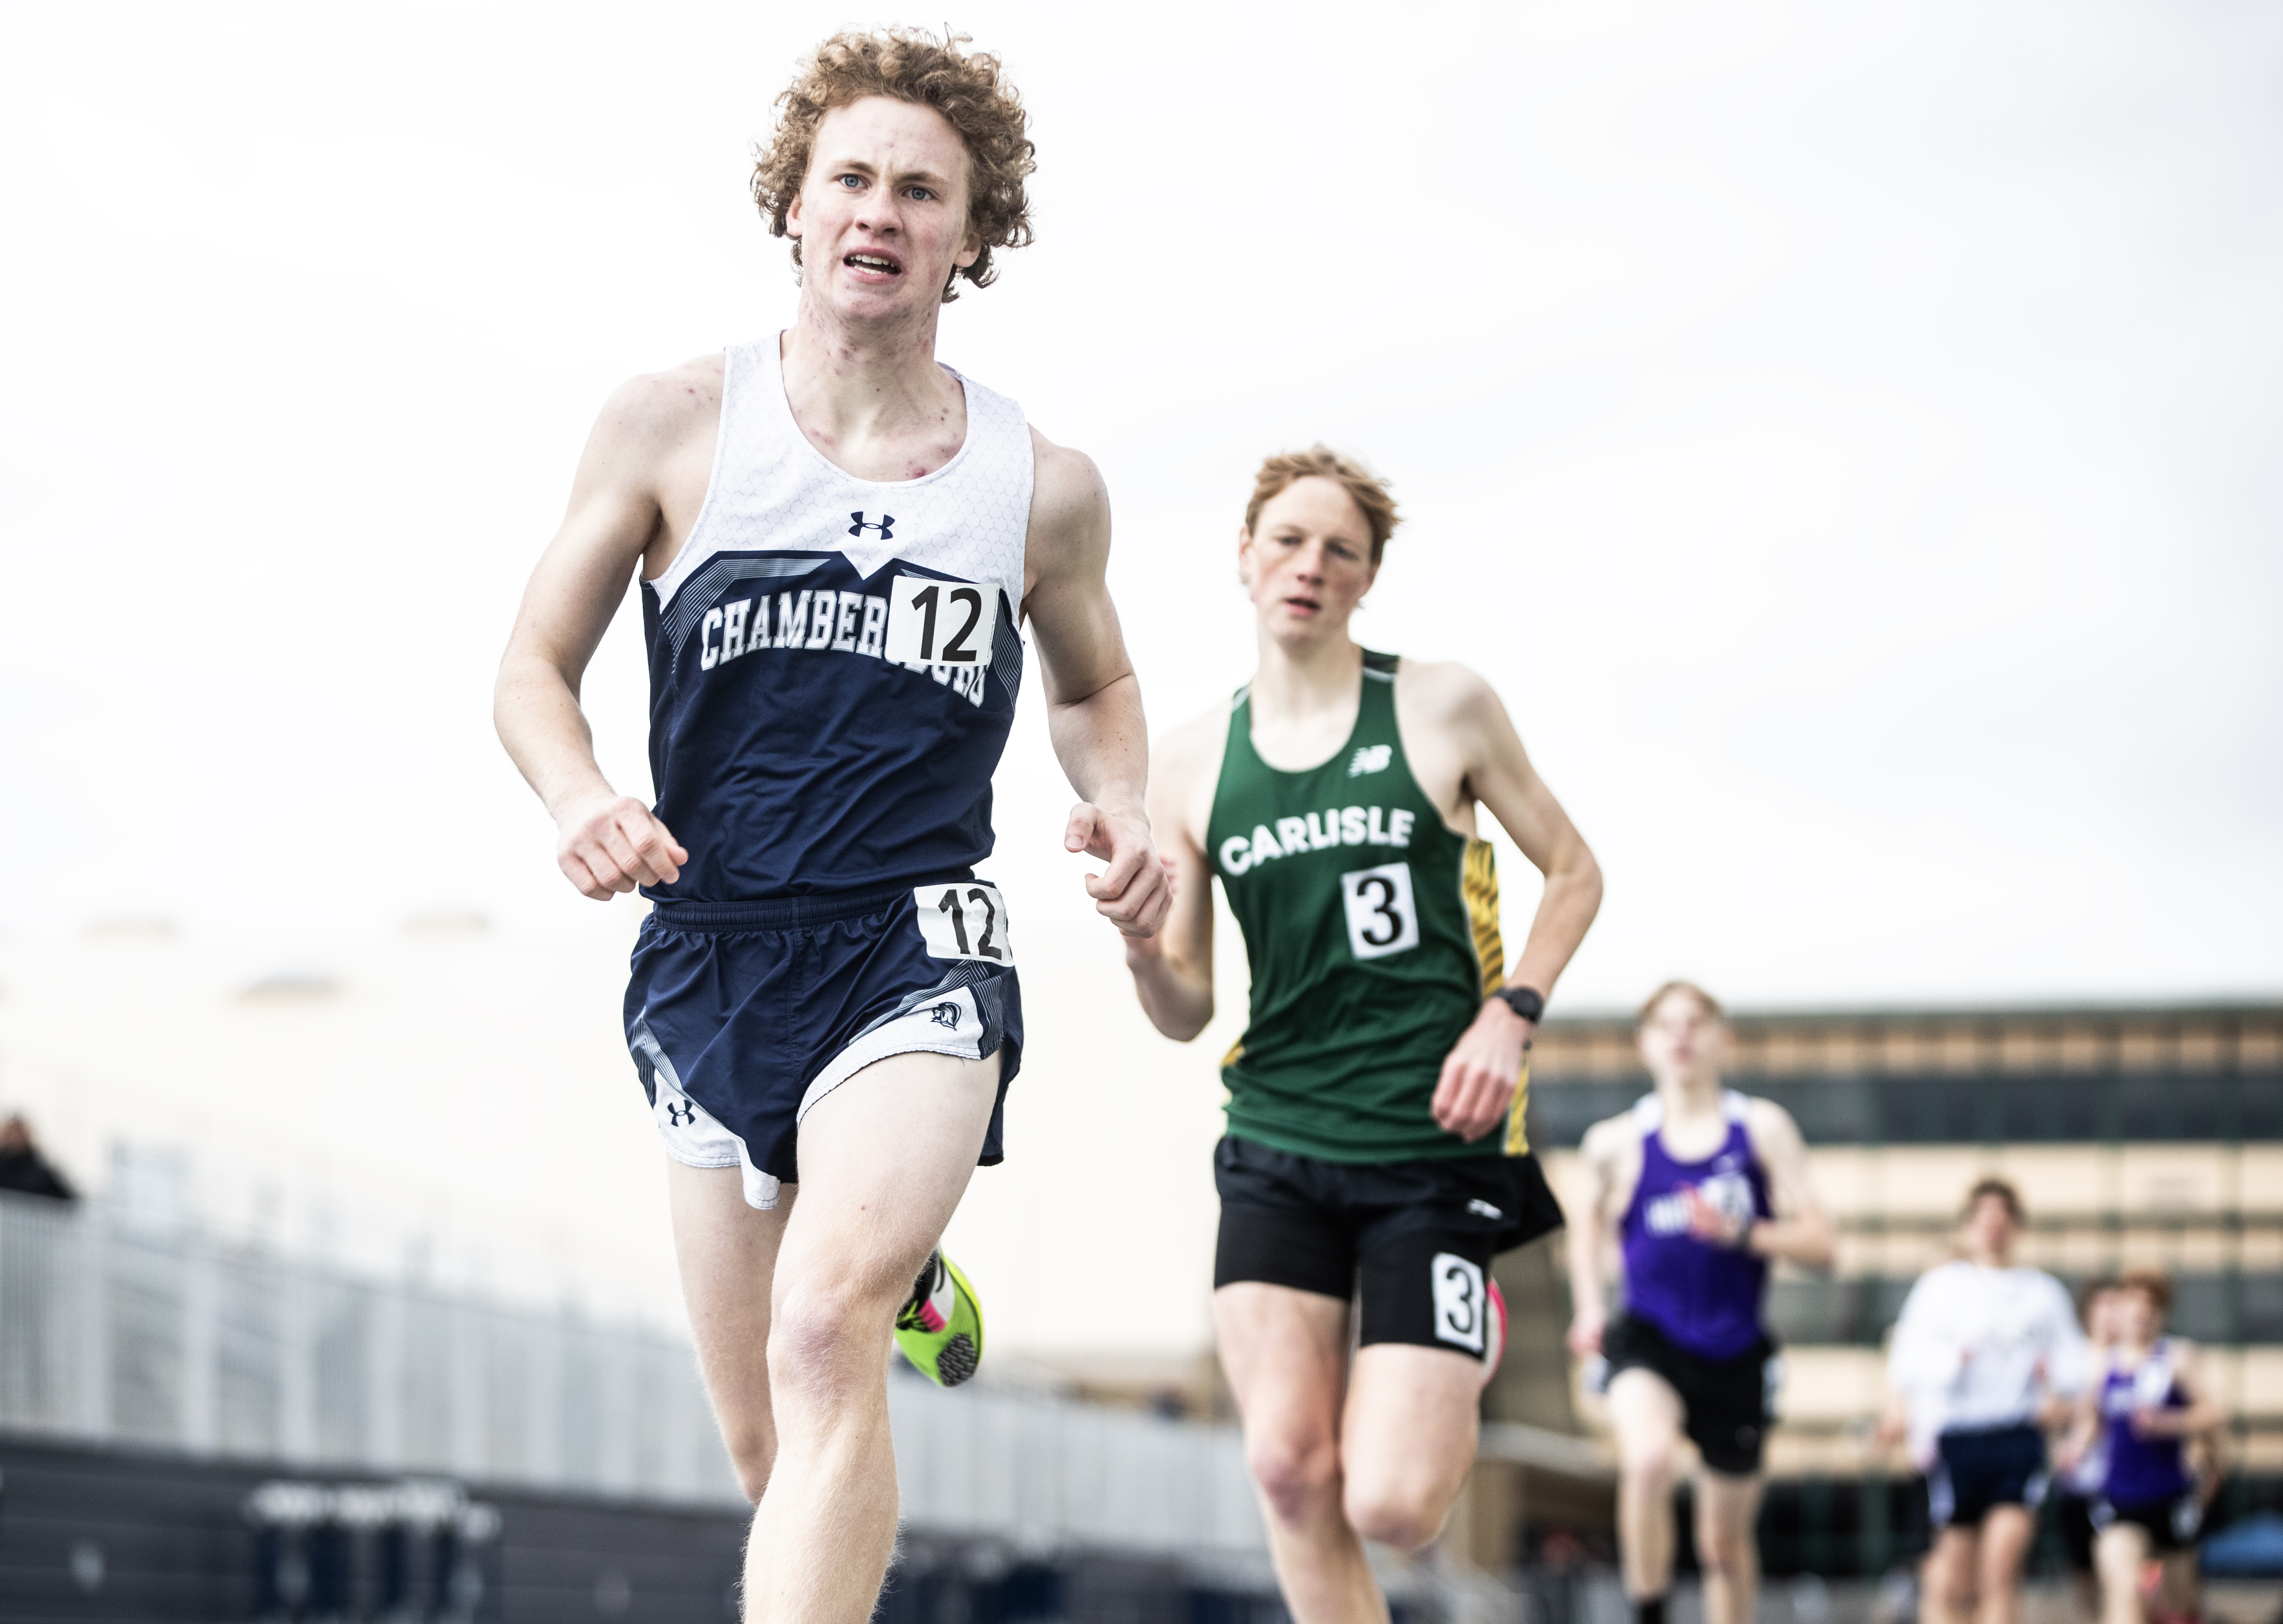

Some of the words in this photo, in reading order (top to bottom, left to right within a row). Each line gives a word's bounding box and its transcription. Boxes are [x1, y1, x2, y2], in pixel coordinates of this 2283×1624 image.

[701, 590, 993, 707] CHAMBER
[911, 585, 982, 661] 12
[1219, 806, 1415, 876] CARLISLE
[938, 888, 1002, 960] 12
[1357, 876, 1405, 946] 3
[1446, 1266, 1472, 1334] 3
